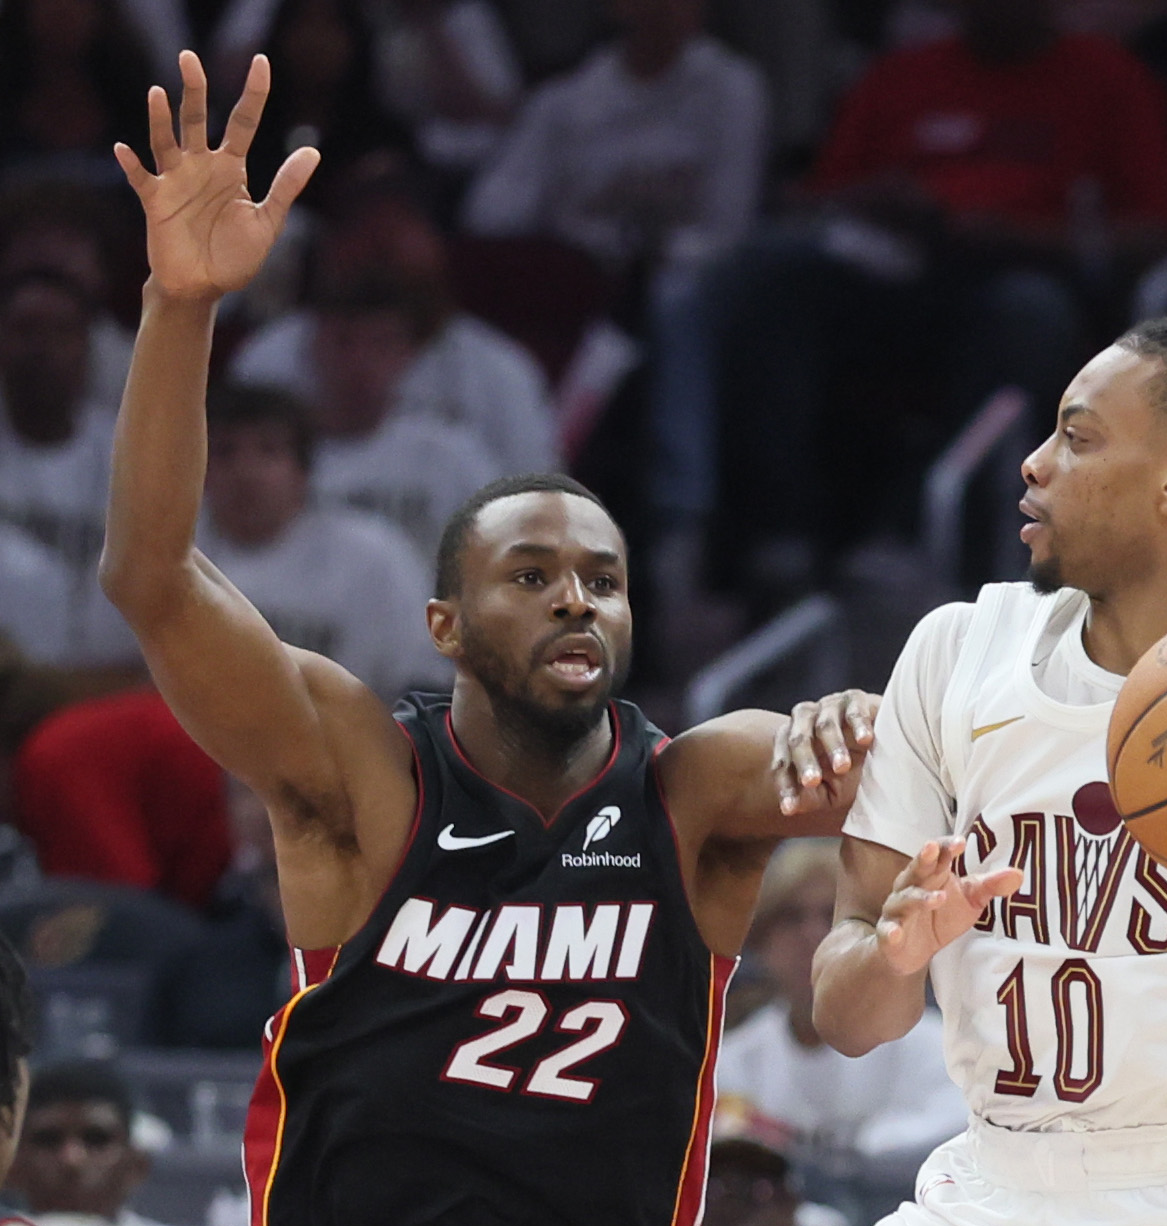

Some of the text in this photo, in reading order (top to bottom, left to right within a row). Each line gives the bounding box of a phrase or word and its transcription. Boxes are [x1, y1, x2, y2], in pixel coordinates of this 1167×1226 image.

[561, 851, 641, 868] Robinhood
[376, 898, 655, 981] MIAMI
[441, 990, 629, 1103] 22
[994, 957, 1104, 1104] 10
